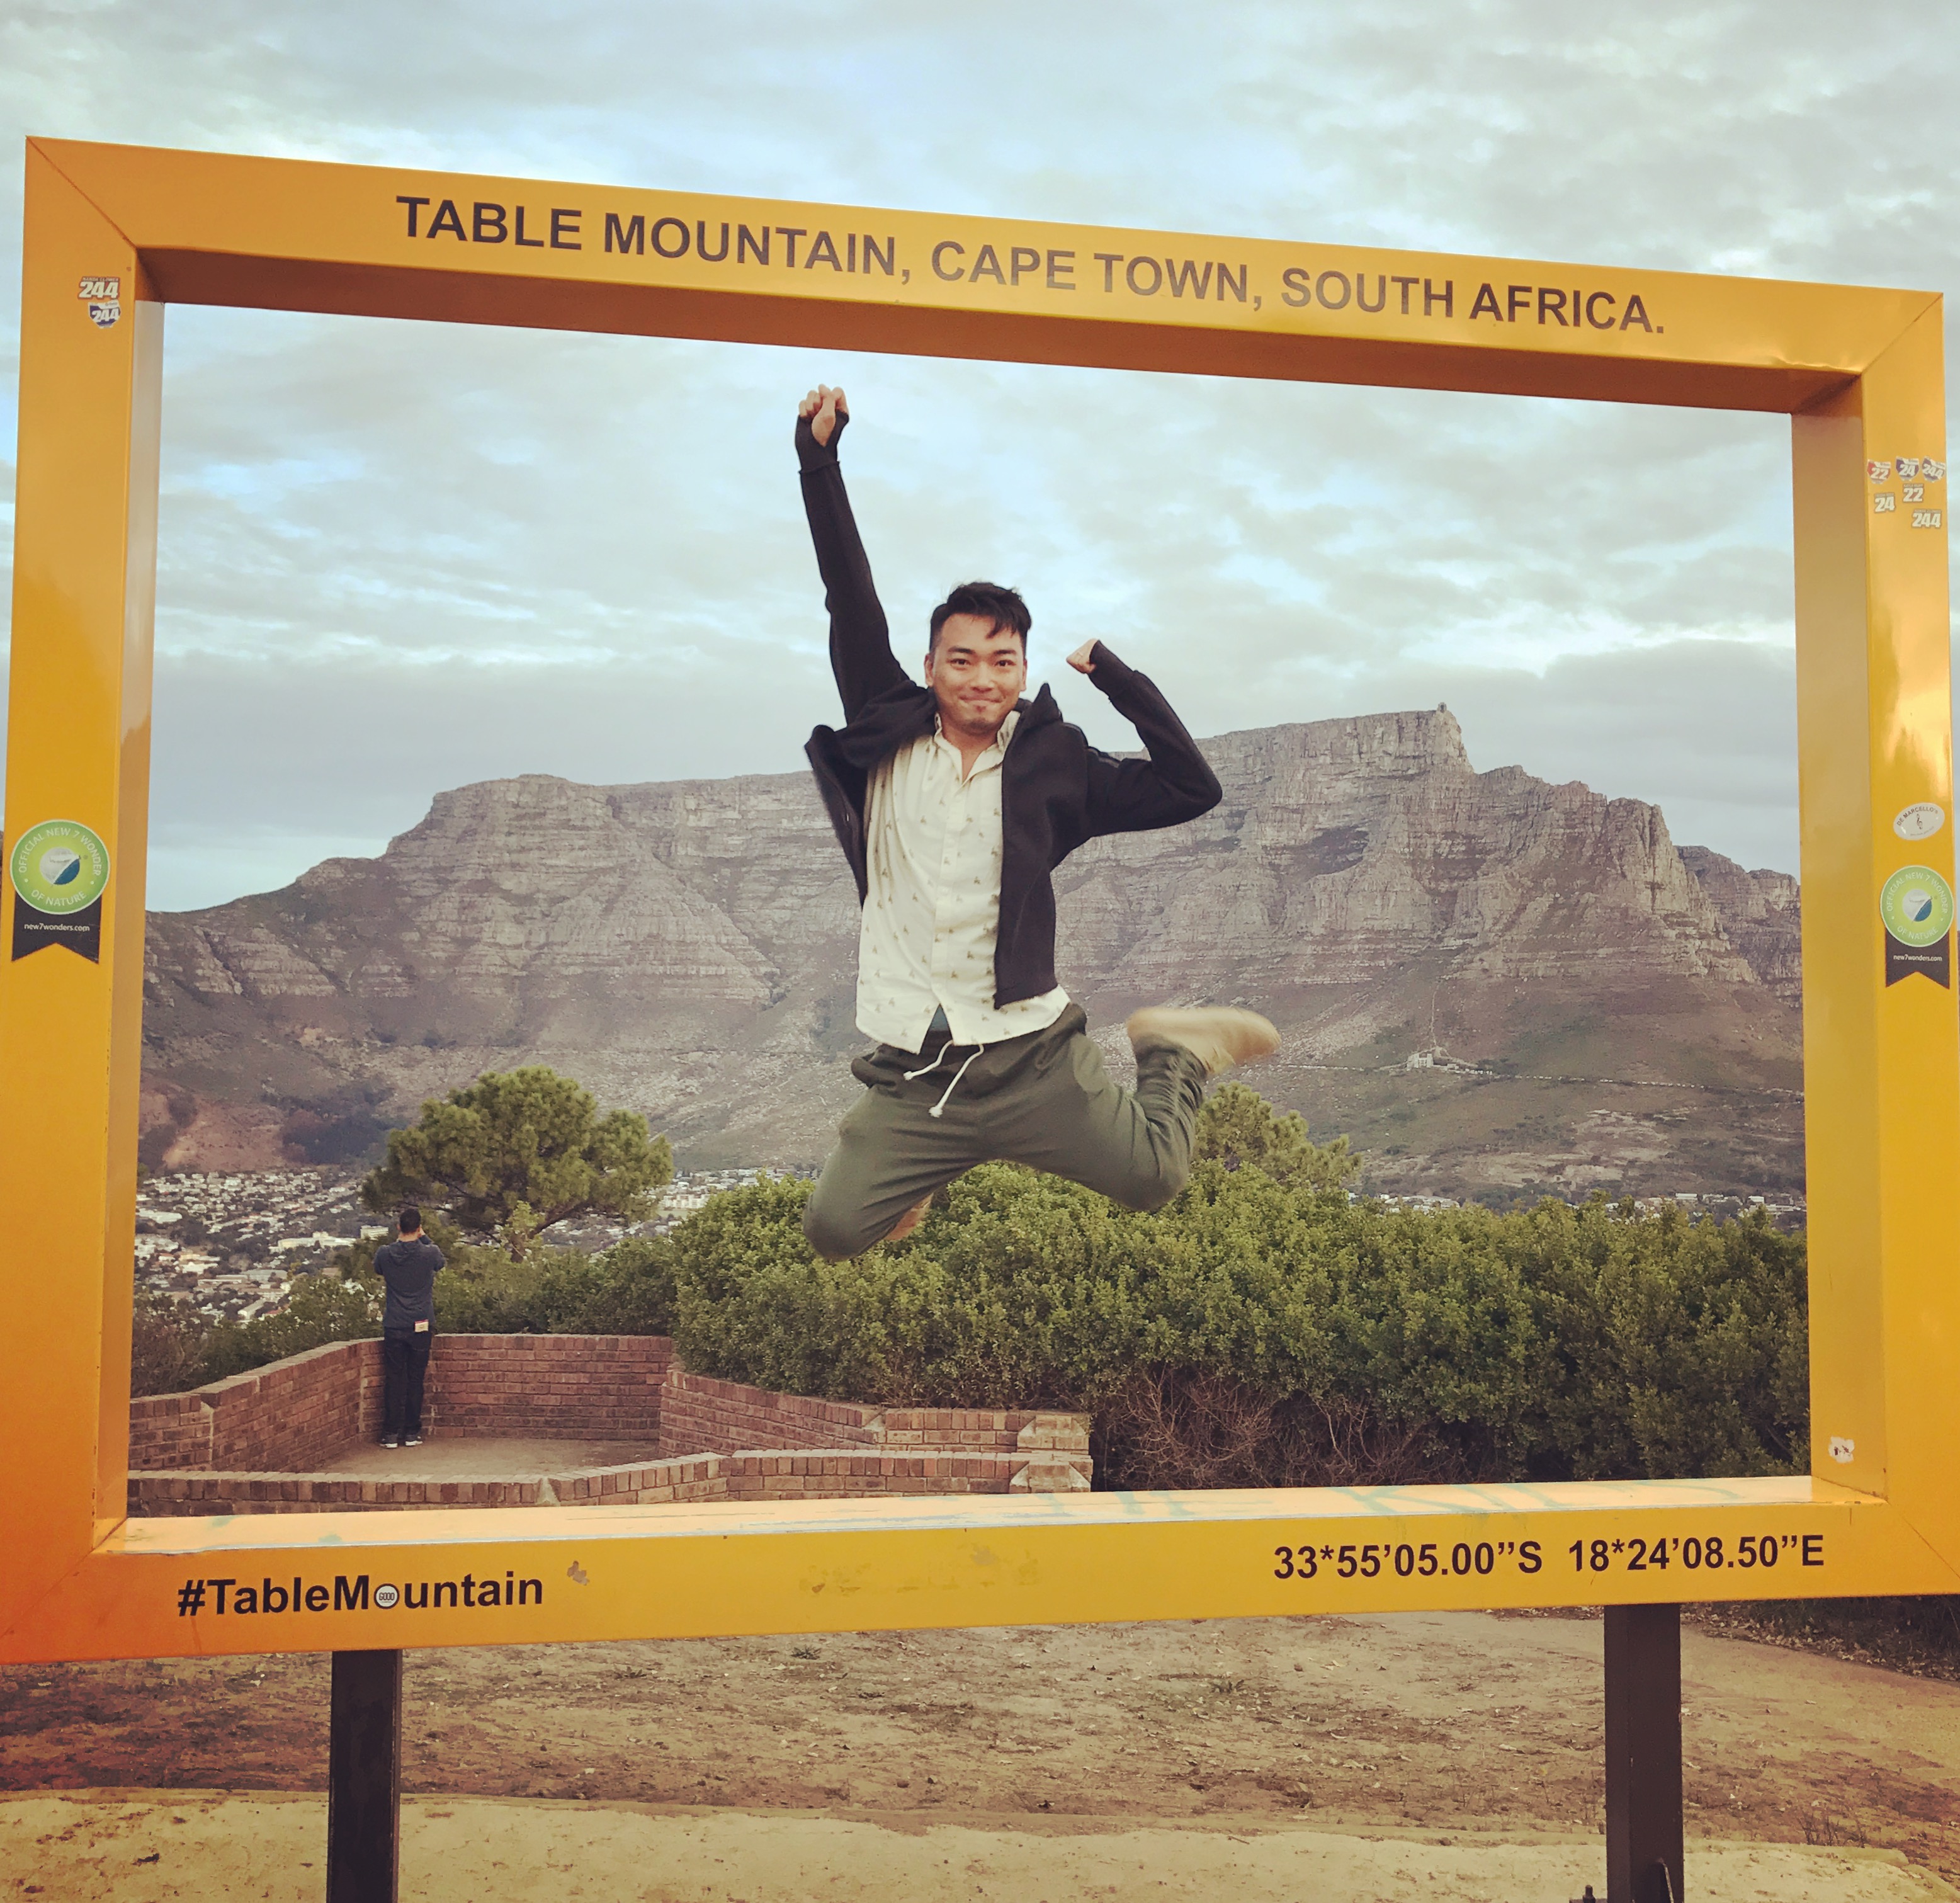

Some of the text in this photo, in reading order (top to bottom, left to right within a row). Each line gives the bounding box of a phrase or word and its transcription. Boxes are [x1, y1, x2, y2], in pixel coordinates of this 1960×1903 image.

[395, 195, 1665, 334] TABLE MOUNTAIN, CAPE TOWN, SOUTH AFRICA.
[79, 281, 118, 298] 244
[91, 308, 119, 322] 244
[1871, 467, 1889, 480] 22
[1898, 463, 1916, 477] 24
[1922, 463, 1945, 480] 244
[1903, 487, 1923, 502] 22
[1874, 496, 1895, 513] 24
[1912, 512, 1941, 528] 244
[1896, 817, 1904, 826] DE
[18, 827, 102, 876] OFFICIAL NEW 7 WONDER
[31, 889, 88, 907] OF NATURE
[1886, 877, 1905, 911] OFFICIAL
[1905, 872, 1923, 880] NEW
[1931, 878, 1948, 914] WONDER
[24, 923, 91, 932] new7wonders.com
[1897, 926, 1939, 940] OF NATURE
[1893, 953, 1943, 962] new7wonders.com
